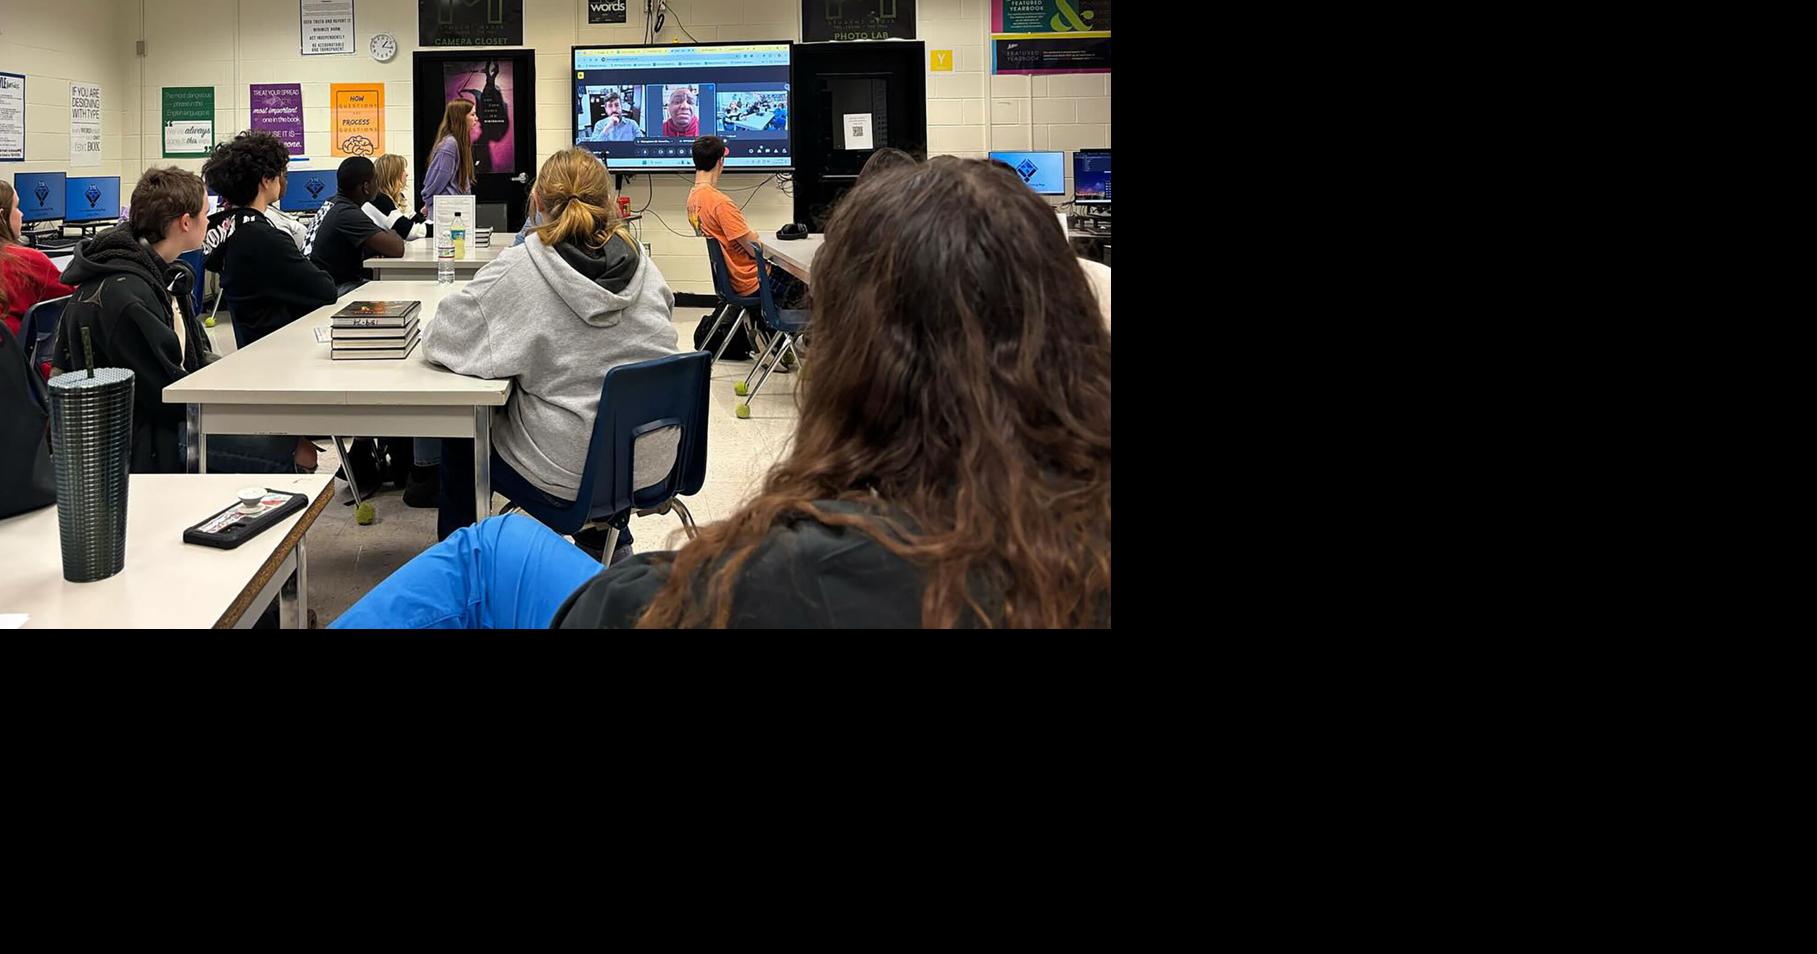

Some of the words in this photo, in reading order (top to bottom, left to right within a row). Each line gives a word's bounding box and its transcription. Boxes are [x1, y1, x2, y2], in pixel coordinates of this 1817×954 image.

[591, 0, 625, 11] words
[834, 32, 868, 40] PHOTO
[871, 31, 889, 39] LAB
[937, 53, 945, 65] Y
[72, 86, 77, 96] IF
[77, 87, 89, 97] YOU
[89, 88, 99, 98] ARE
[72, 97, 100, 109] DESIGNING
[72, 109, 86, 119] WITH
[87, 109, 99, 120] TYPE
[268, 106, 297, 115] important
[185, 126, 211, 138] always
[186, 136, 197, 144] this
[87, 141, 100, 152] BOX
